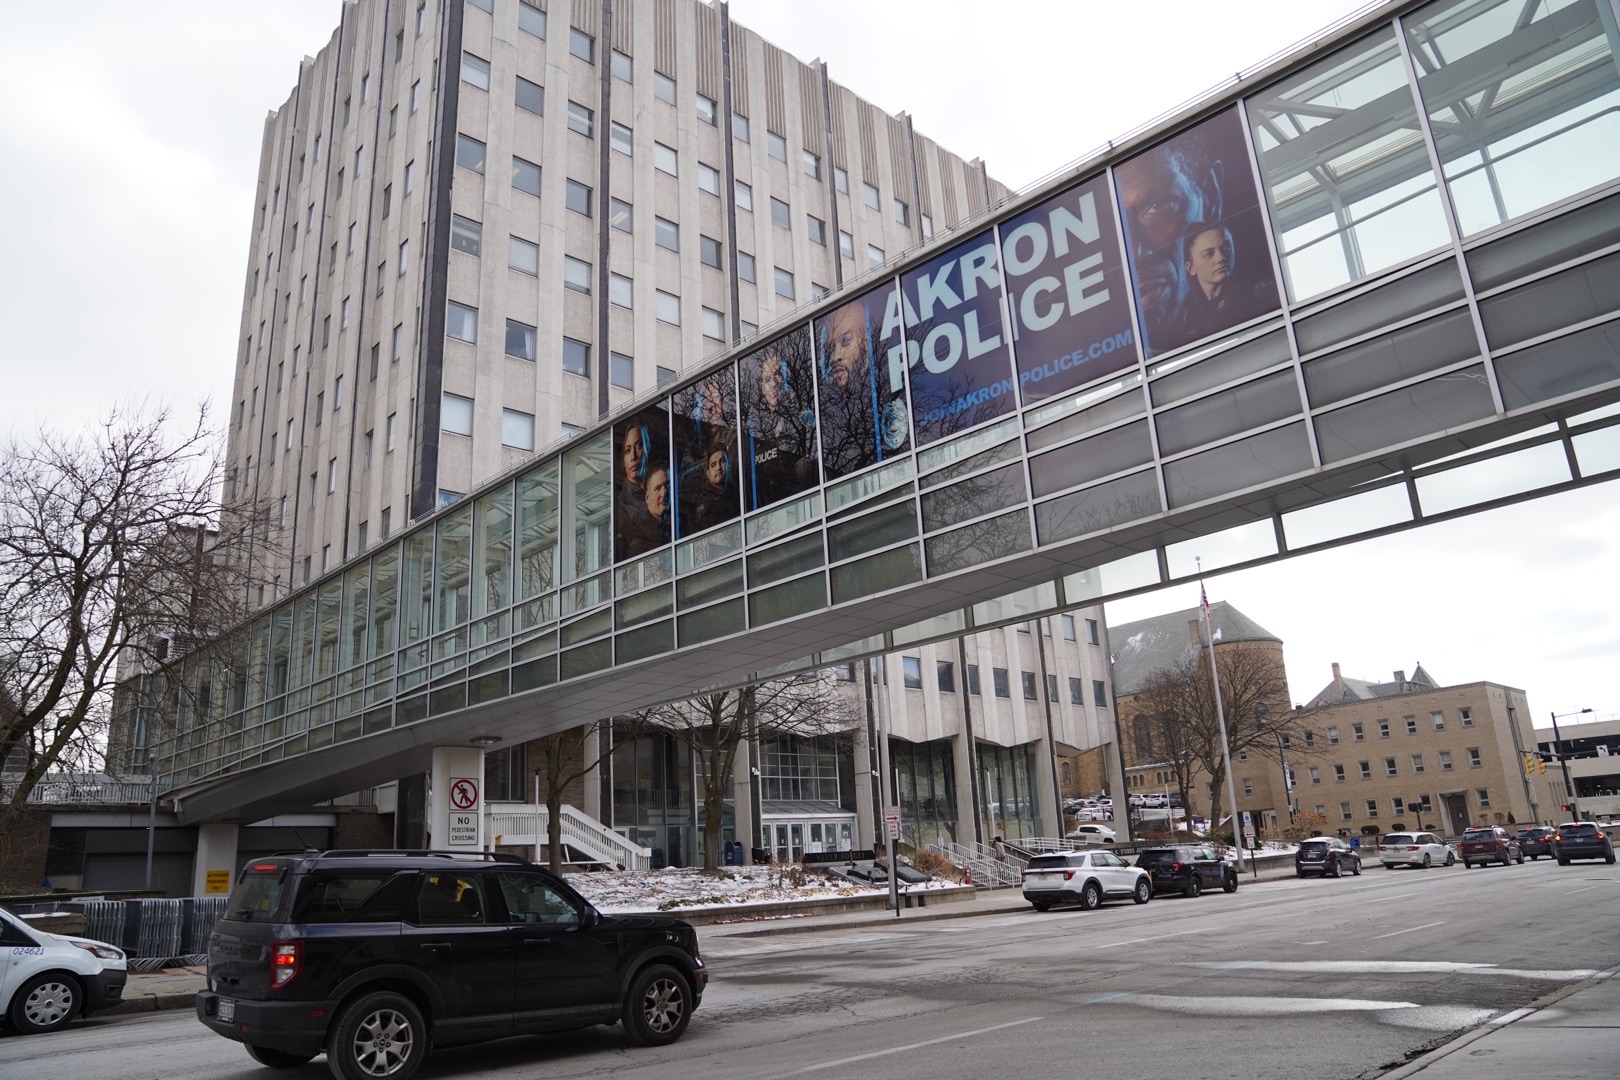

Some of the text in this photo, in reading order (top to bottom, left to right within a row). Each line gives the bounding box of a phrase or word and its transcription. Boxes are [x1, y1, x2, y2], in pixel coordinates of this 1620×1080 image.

[880, 191, 1101, 341] AKRON
[887, 252, 1110, 393] POLICE
[755, 447, 778, 465] POLICE
[457, 817, 470, 825] NO
[12, 947, 45, 956] 024621
